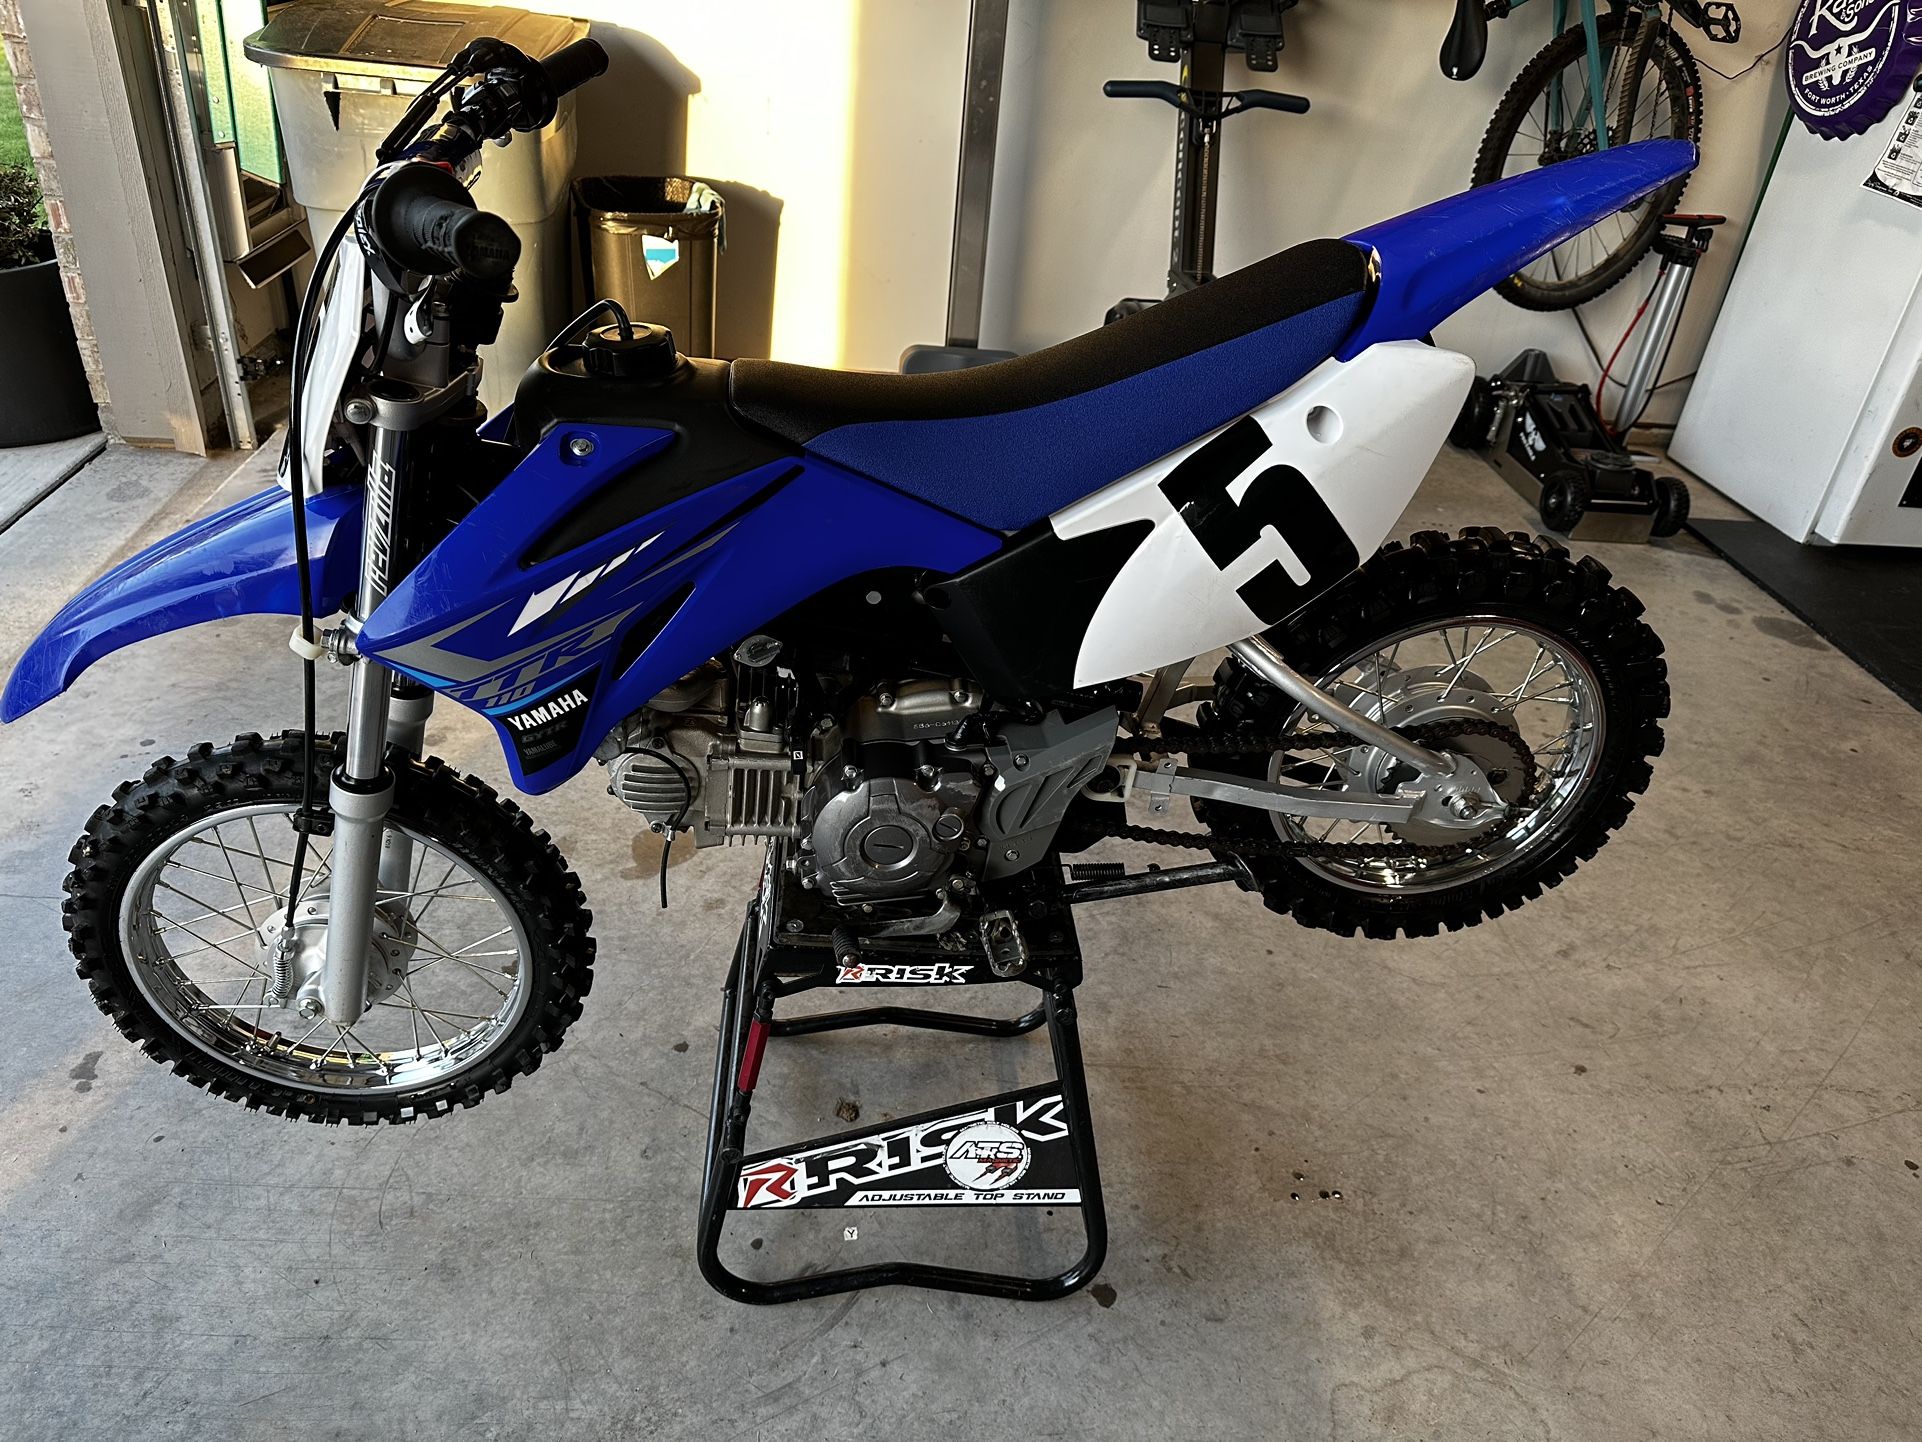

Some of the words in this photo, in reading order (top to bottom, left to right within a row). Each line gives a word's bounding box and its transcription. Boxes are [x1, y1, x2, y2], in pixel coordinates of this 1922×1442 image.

[1804, 65, 1836, 82] BREWING
[1838, 51, 1873, 69] COMPANY
[1804, 88, 1820, 103] FORT
[1821, 93, 1846, 105] WORTH
[1850, 65, 1873, 93] TEXAS
[1158, 415, 1360, 626] 5
[507, 689, 589, 731] YAMAHA
[864, 963, 975, 983] RISK
[858, 1192, 965, 1202] ADJUSTABLE
[974, 1192, 1005, 1201] TOP
[1012, 1192, 1065, 1201] STAND
